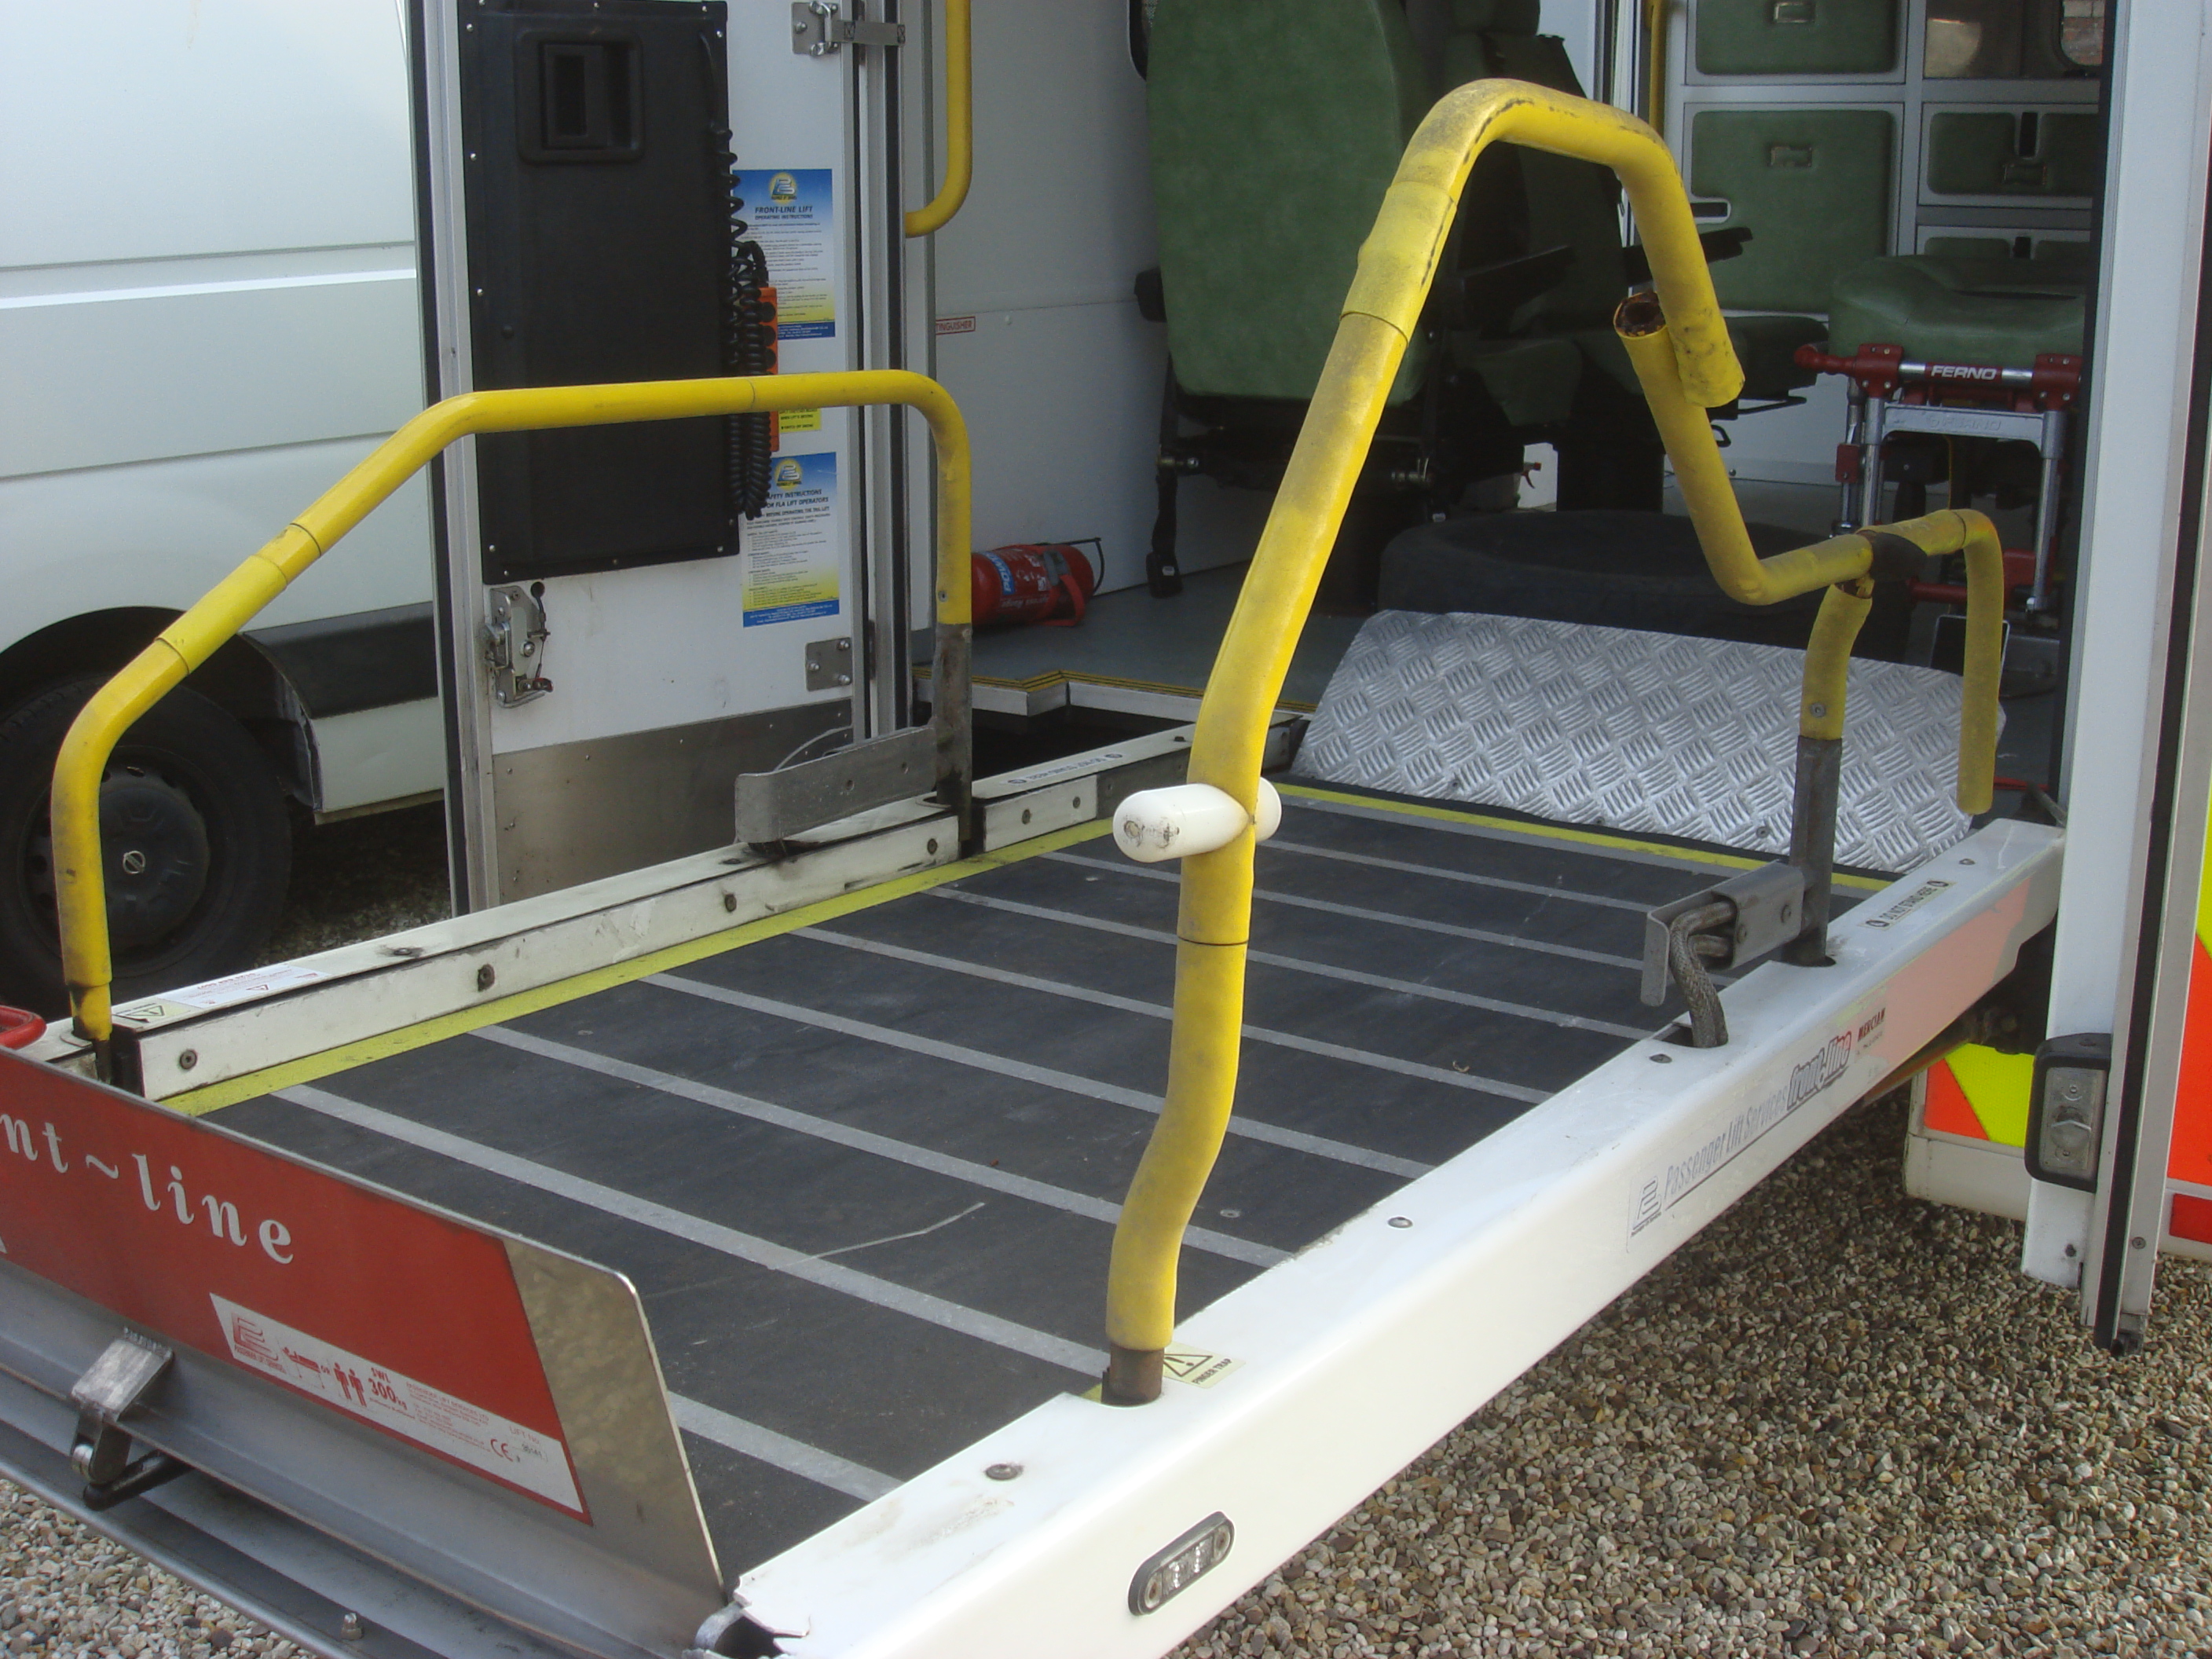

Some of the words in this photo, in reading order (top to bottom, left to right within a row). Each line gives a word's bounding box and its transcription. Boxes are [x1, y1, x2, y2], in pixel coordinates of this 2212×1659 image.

[936, 320, 972, 331] TINGUISHER
[1931, 364, 1998, 381] FERNO
[786, 489, 822, 498] INSTRUCTIONS
[1899, 895, 1924, 907] STAND
[1858, 1007, 1885, 1042] MERCIAN
[1664, 1132, 1727, 1200] Passenger
[1726, 1115, 1745, 1154] Lift
[1744, 1086, 1788, 1140] Services
[0, 1114, 294, 1264] nt~line
[371, 1368, 391, 1383] SWL
[1192, 1368, 1218, 1385] FINGER
[1212, 1358, 1232, 1370] TRAP
